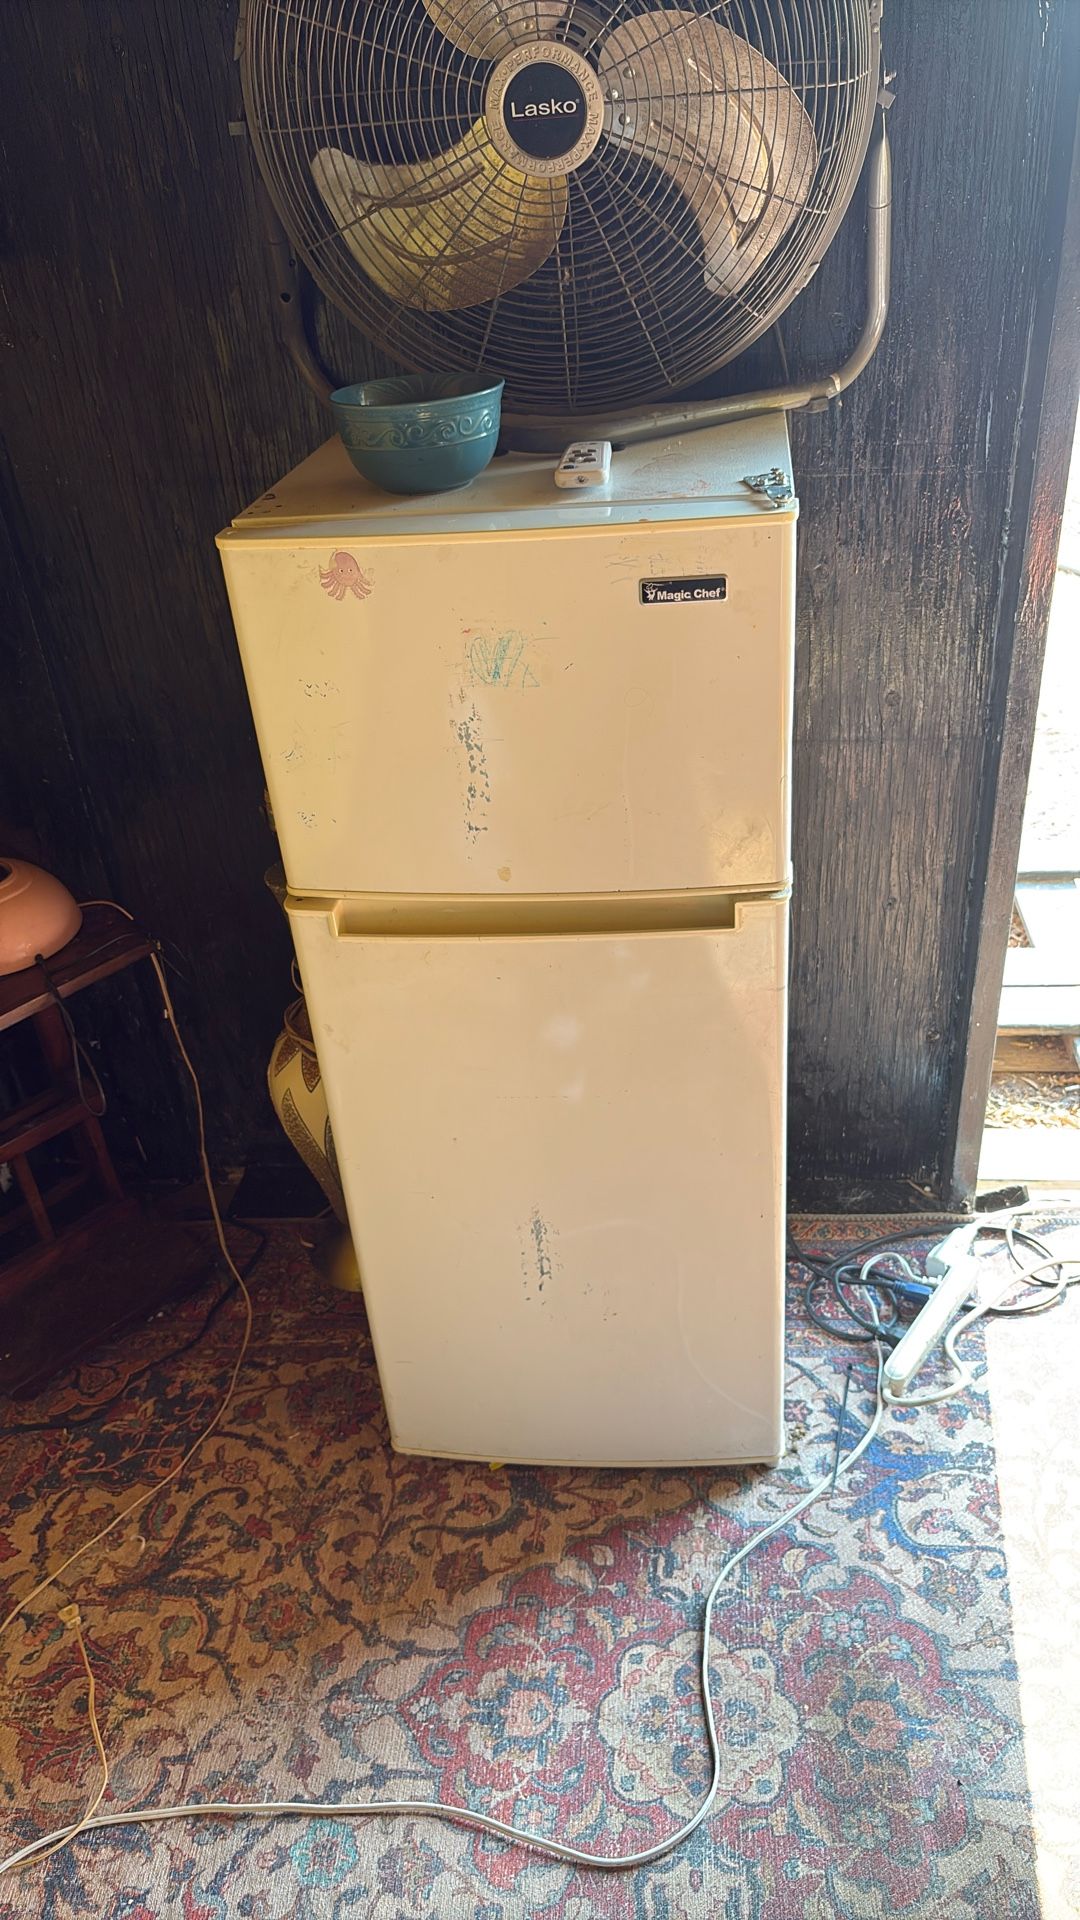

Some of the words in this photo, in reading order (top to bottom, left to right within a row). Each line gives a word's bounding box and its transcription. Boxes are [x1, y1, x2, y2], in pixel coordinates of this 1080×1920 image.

[511, 98, 577, 118] Lasko
[657, 590, 691, 602] Magic
[694, 588, 721, 598] Chef
